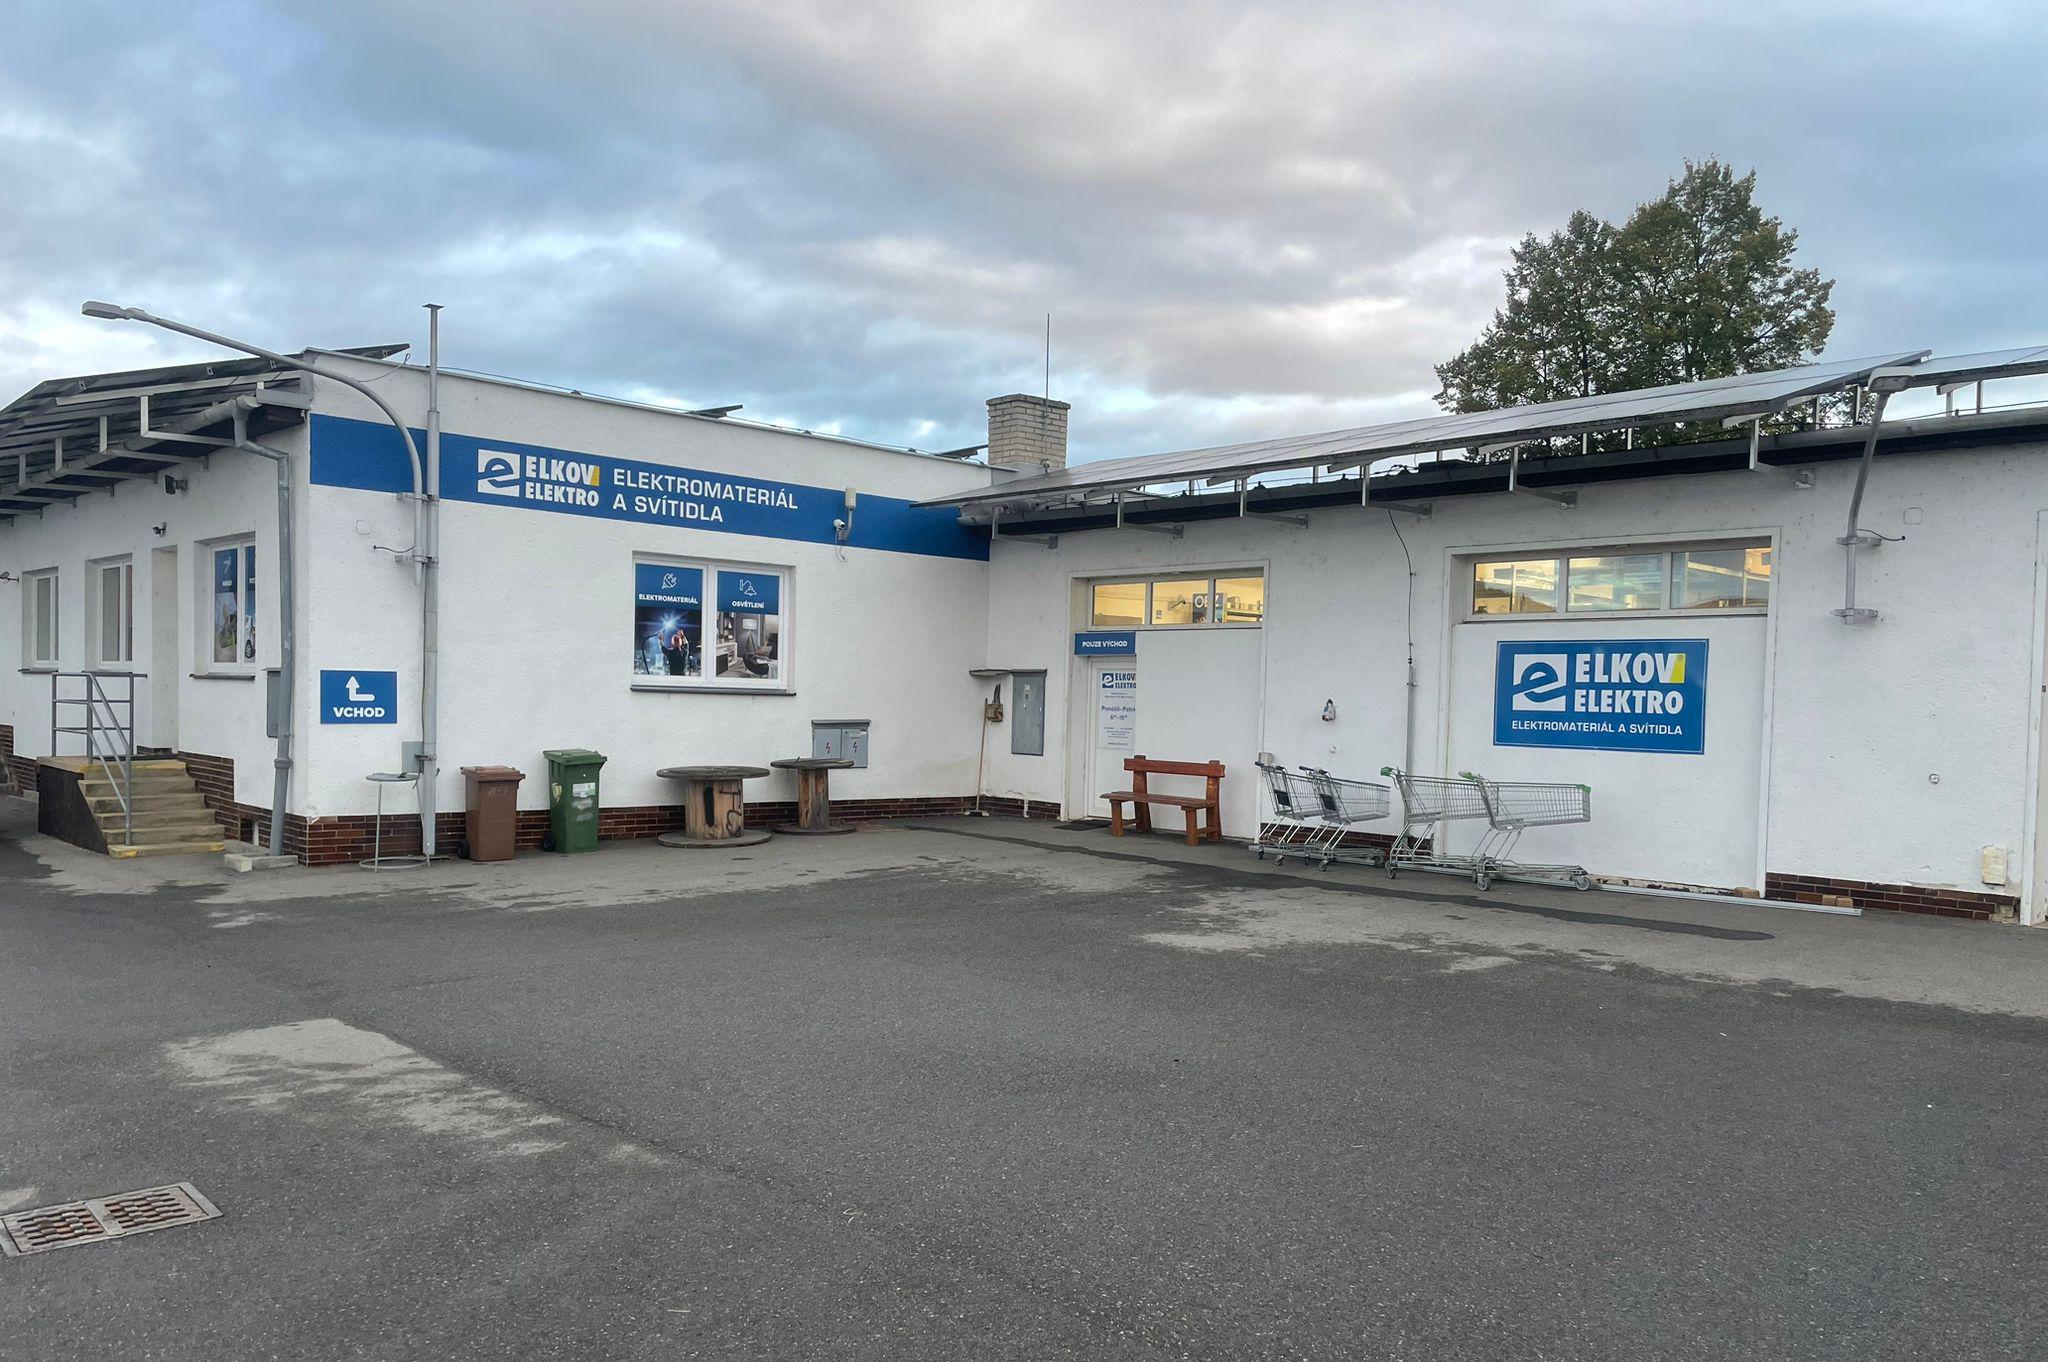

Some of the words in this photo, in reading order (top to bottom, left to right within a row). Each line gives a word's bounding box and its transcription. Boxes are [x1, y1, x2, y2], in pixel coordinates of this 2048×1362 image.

[525, 481, 600, 507] ELEKTRO
[613, 468, 798, 510] ELEKTROMATERIÁL
[612, 493, 627, 511] A
[634, 495, 723, 523] SVÍTIDLA
[638, 593, 699, 605] ELEKTROMATERIÁL
[731, 600, 765, 609] OSVĚTLENÍ
[1102, 640, 1128, 648] VÝCHOD
[1574, 689, 1684, 715] ELEKTRO
[333, 707, 386, 718] VCHOD
[1512, 720, 1615, 733] ELEKTROMATERIÁL
[1617, 724, 1626, 733] A
[1629, 722, 1683, 735] SVÍTIDLA
